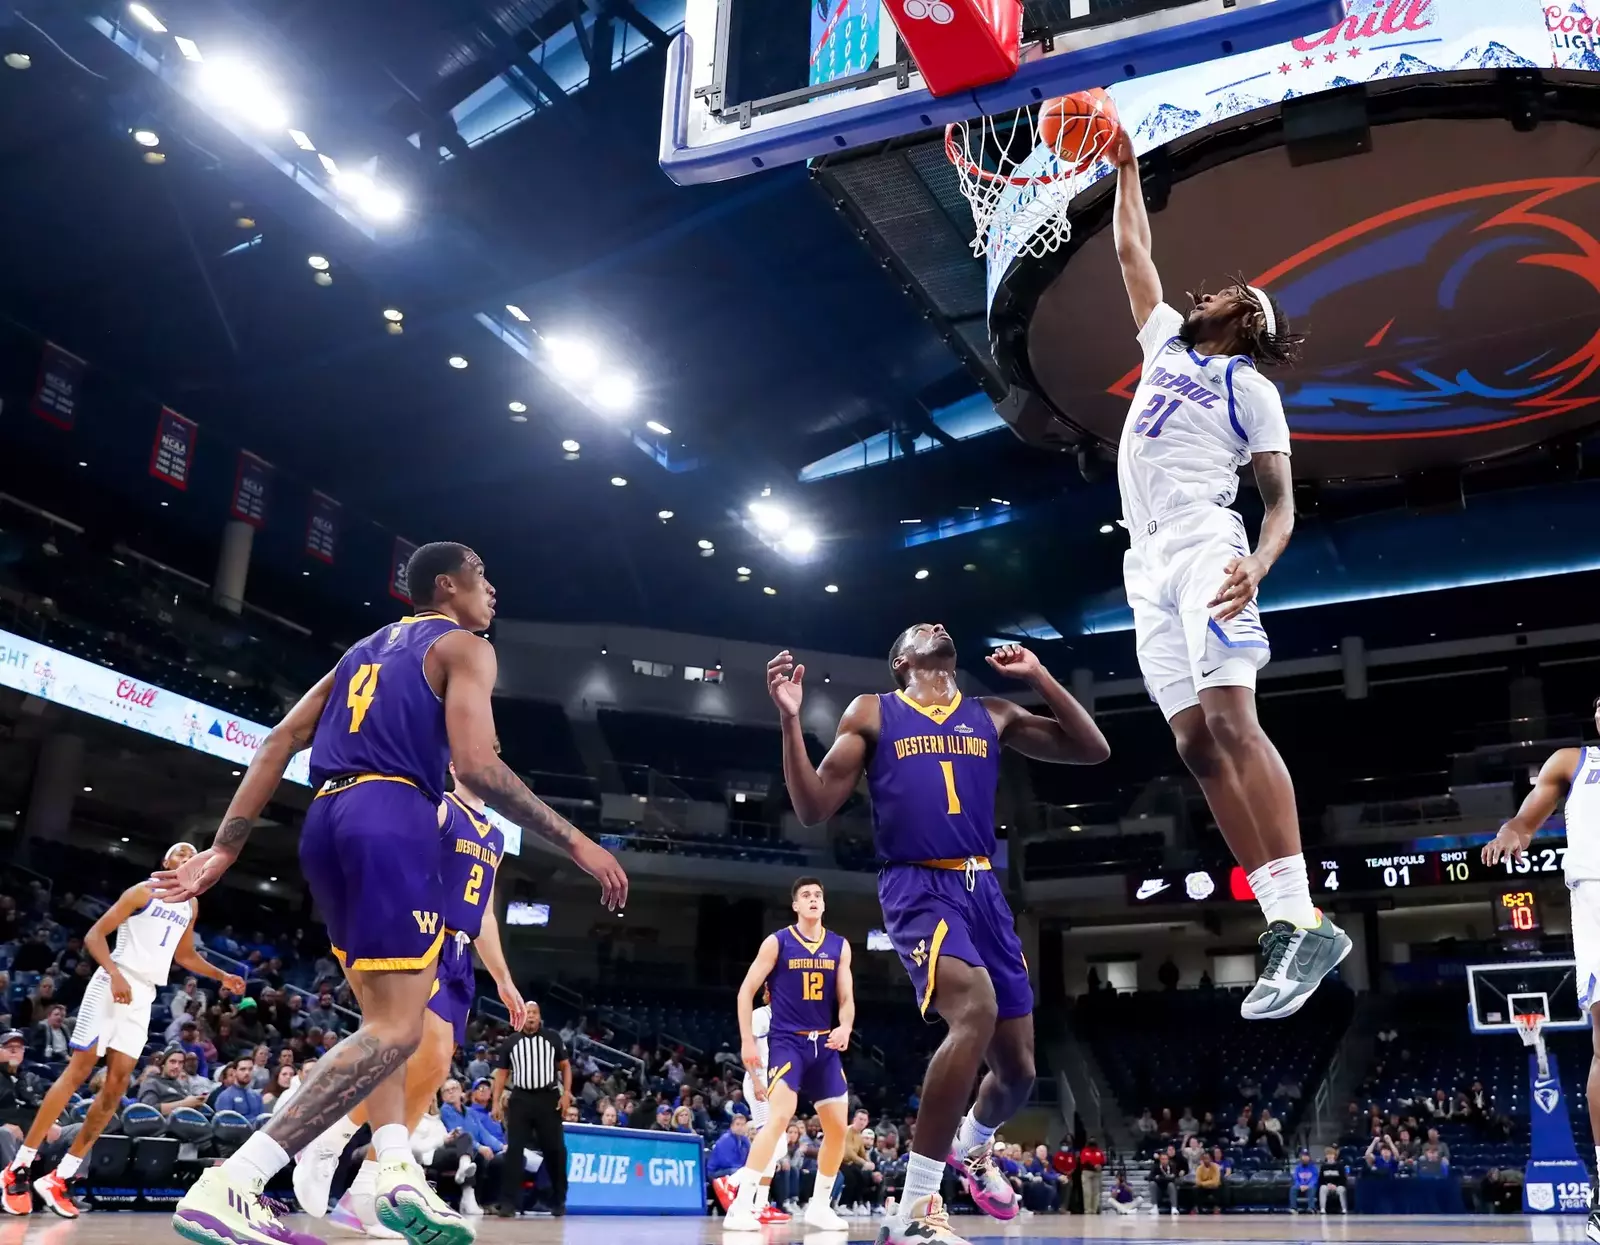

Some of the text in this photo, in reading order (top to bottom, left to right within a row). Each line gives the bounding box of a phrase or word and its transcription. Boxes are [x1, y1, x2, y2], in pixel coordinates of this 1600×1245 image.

[1543, 5, 1600, 36] Coo
[1132, 393, 1183, 439] 21
[116, 678, 160, 709] Chill
[346, 663, 383, 734] 4
[894, 735, 988, 760] WESTERN ILLINOIS
[938, 760, 961, 815] 1
[1321, 860, 1339, 870] TOL
[1365, 857, 1392, 868] TEAM
[1393, 855, 1425, 866] FOULS
[1441, 852, 1468, 862] SHOT
[463, 863, 484, 906] 2
[1324, 863, 1470, 891] 4 01 10
[1502, 892, 1534, 908] 15:27
[412, 910, 438, 935] W
[1512, 906, 1533, 930] 10
[159, 925, 171, 947] 1
[788, 958, 836, 971] WESTERN ILLINOIS
[802, 971, 824, 1001] 12
[567, 1152, 697, 1187] BLUE GRIT
[1556, 1182, 1591, 1199] 125
